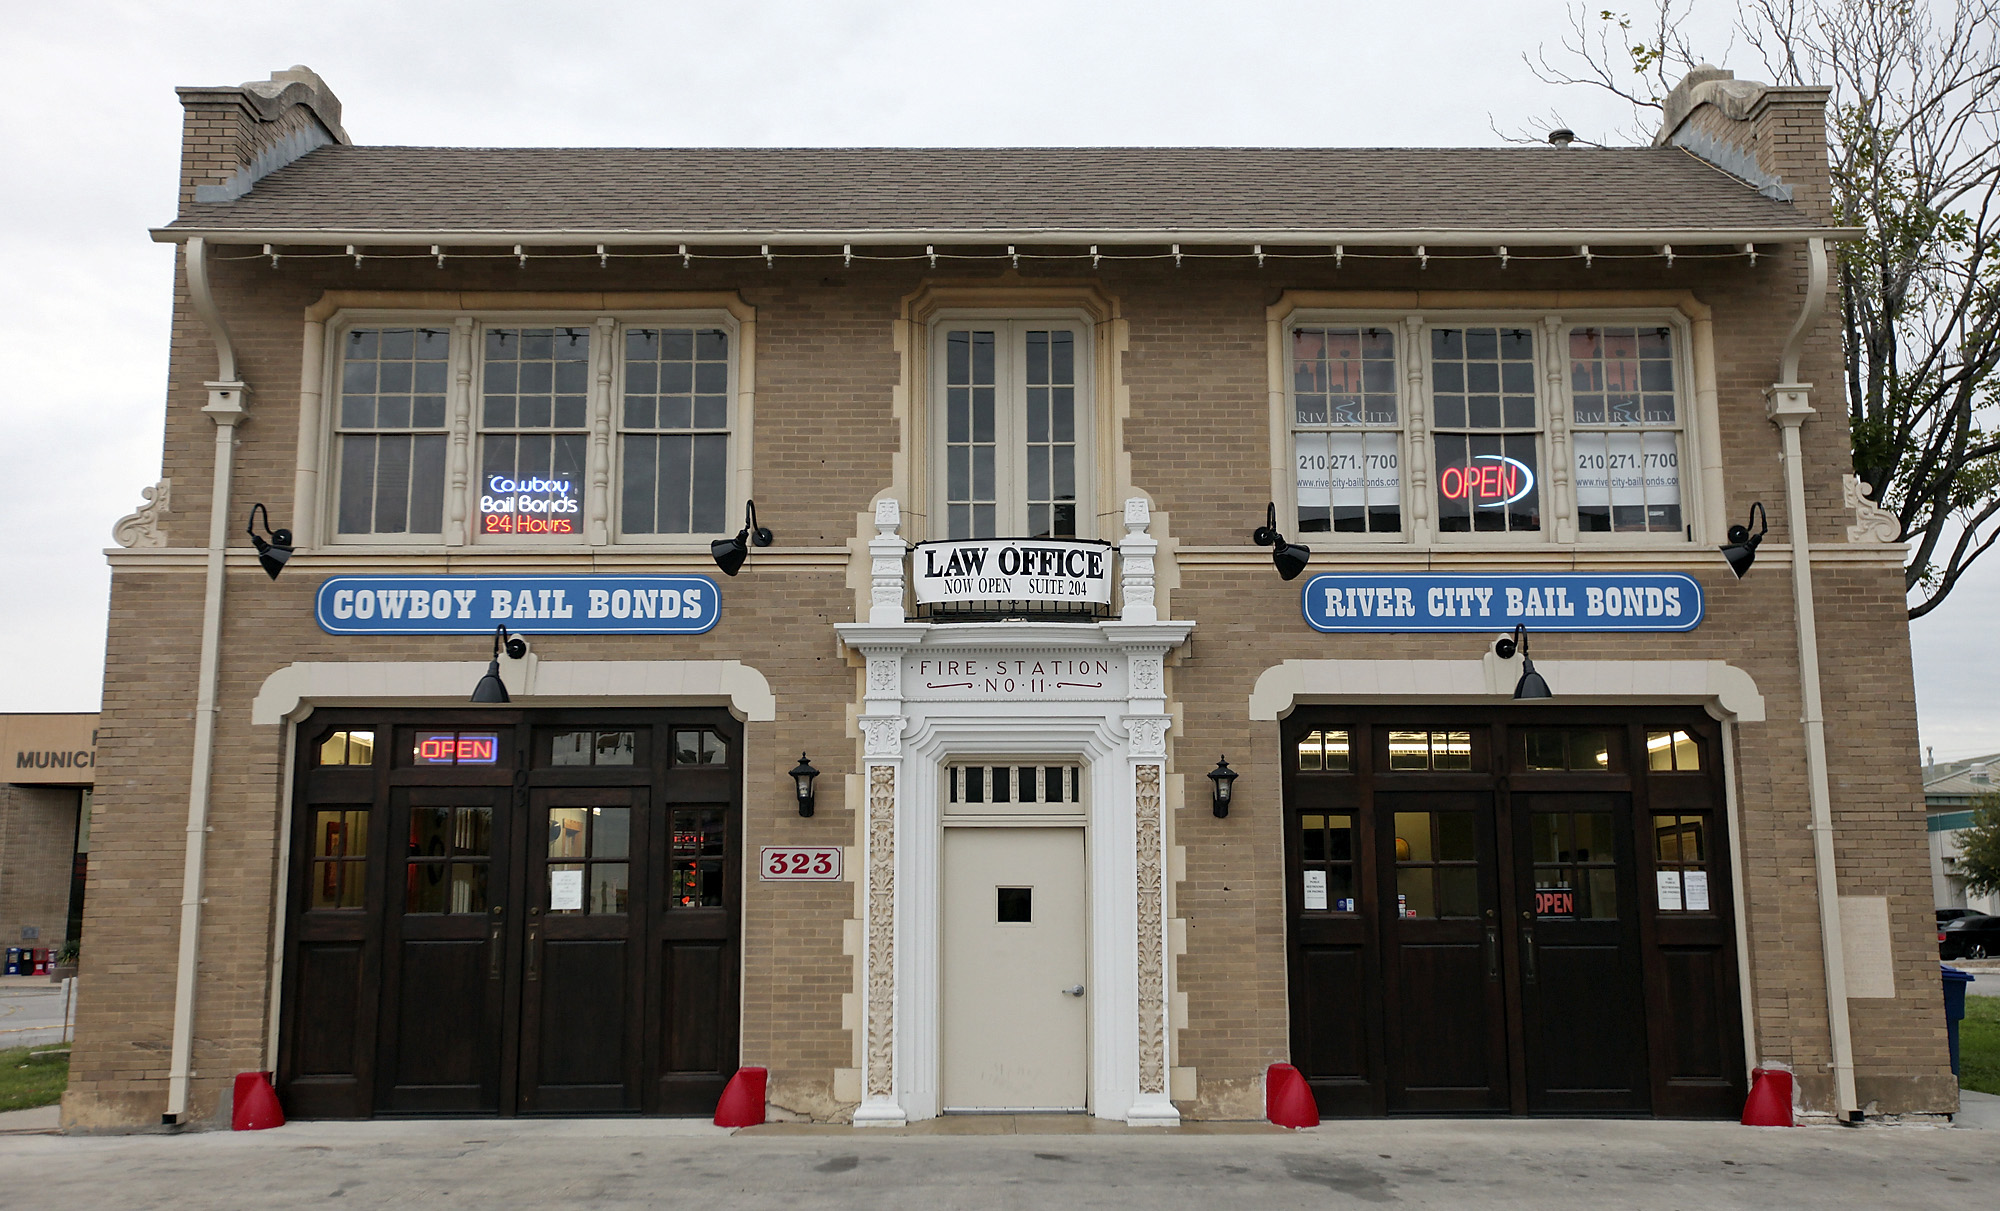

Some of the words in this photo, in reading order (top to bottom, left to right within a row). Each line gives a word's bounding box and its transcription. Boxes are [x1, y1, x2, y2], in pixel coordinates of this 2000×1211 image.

[1298, 411, 1345, 422] RIVR
[1357, 410, 1394, 422] CITY
[1634, 410, 1672, 421] CITY
[1299, 454, 1397, 470] 210.271.7700
[1579, 453, 1678, 469] 210.271.7700
[490, 476, 569, 498] Cowboy
[1441, 465, 1517, 499] OPEN
[480, 495, 514, 512] Bail
[518, 495, 578, 512] Bonds
[486, 514, 512, 532] 24
[517, 514, 572, 532] Hours
[924, 548, 989, 578] LAW
[999, 547, 1104, 579] OFFICE
[944, 578, 974, 595] NOW
[978, 577, 1012, 593] OPEN
[1028, 578, 1065, 594] SUITE
[1068, 581, 1088, 596] 204
[333, 589, 476, 619] COWBOY
[490, 589, 573, 619] BAIL
[588, 589, 702, 619] BONDS
[1325, 588, 1415, 617] RIVER
[1428, 587, 1494, 616] CITY
[1505, 587, 1575, 616] BAIL
[1587, 586, 1682, 617] BONDS
[920, 661, 977, 675] FIRE
[996, 660, 1109, 675] STATION
[1031, 678, 1044, 692] 11
[421, 740, 492, 758] OPEN
[769, 853, 832, 874] 323
[1535, 893, 1573, 913] OPEN
